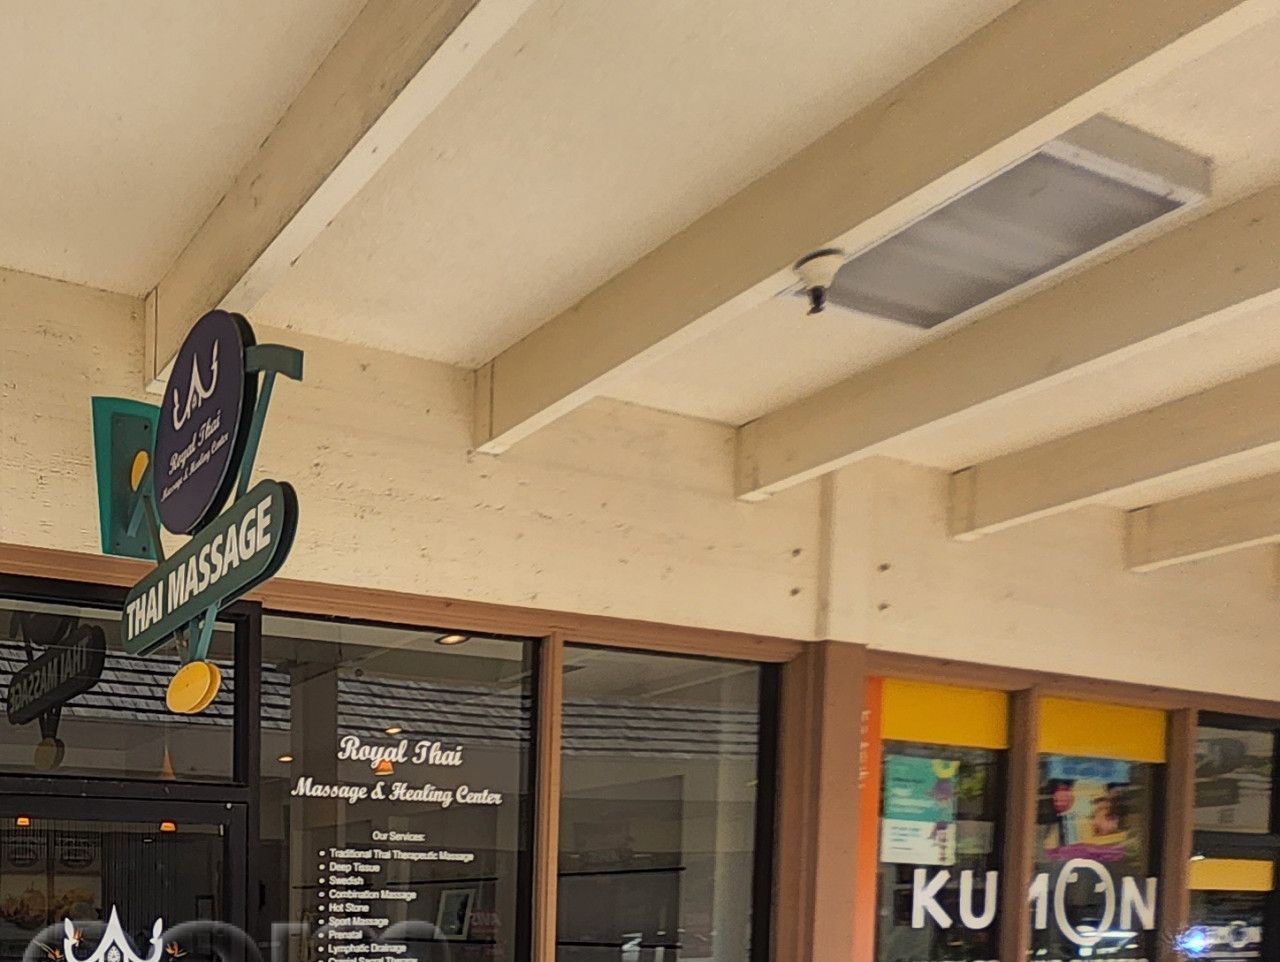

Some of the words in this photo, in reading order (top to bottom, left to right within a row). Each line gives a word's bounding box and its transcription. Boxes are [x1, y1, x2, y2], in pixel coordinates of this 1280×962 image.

[125, 580, 164, 641] THAI
[167, 494, 272, 614] MASSAGE
[338, 735, 408, 769] Royal
[412, 741, 463, 766] Thai
[291, 777, 368, 804] Massage
[371, 781, 386, 800] &
[389, 782, 453, 808] Healing
[455, 785, 502, 805] Center
[372, 830, 389, 841] Our
[439, 851, 474, 863] Massage
[329, 862, 352, 873] Deep
[329, 876, 364, 885] Swedish
[380, 890, 417, 901] Massage
[328, 903, 345, 912] Hot
[345, 903, 369, 913] Stone
[328, 917, 351, 927] Sport
[352, 917, 389, 928] Massage
